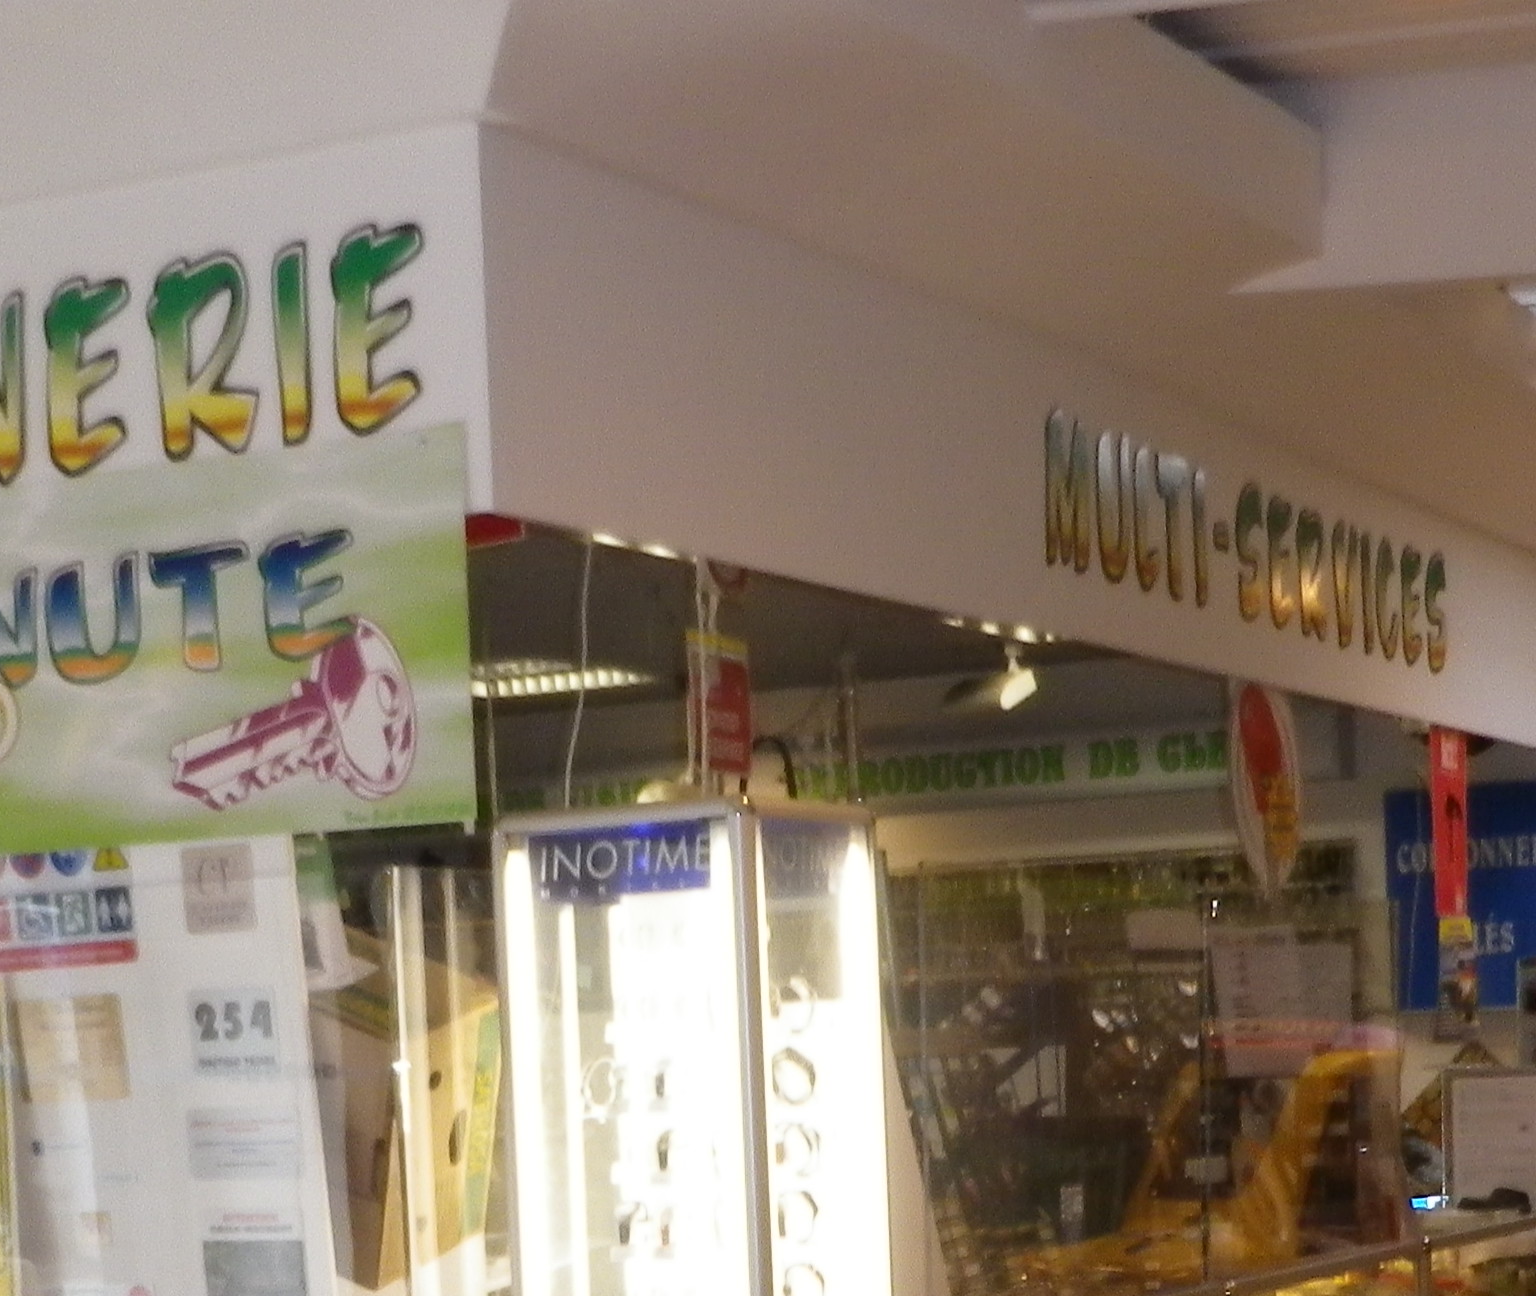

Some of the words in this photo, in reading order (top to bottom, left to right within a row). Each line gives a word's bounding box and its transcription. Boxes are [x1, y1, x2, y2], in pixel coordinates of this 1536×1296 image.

[1044, 405, 1449, 674] MULTI-SERVICES
[1157, 729, 1229, 774] CLE
[539, 832, 711, 883] INOTIME
[194, 1000, 273, 1042] 254
